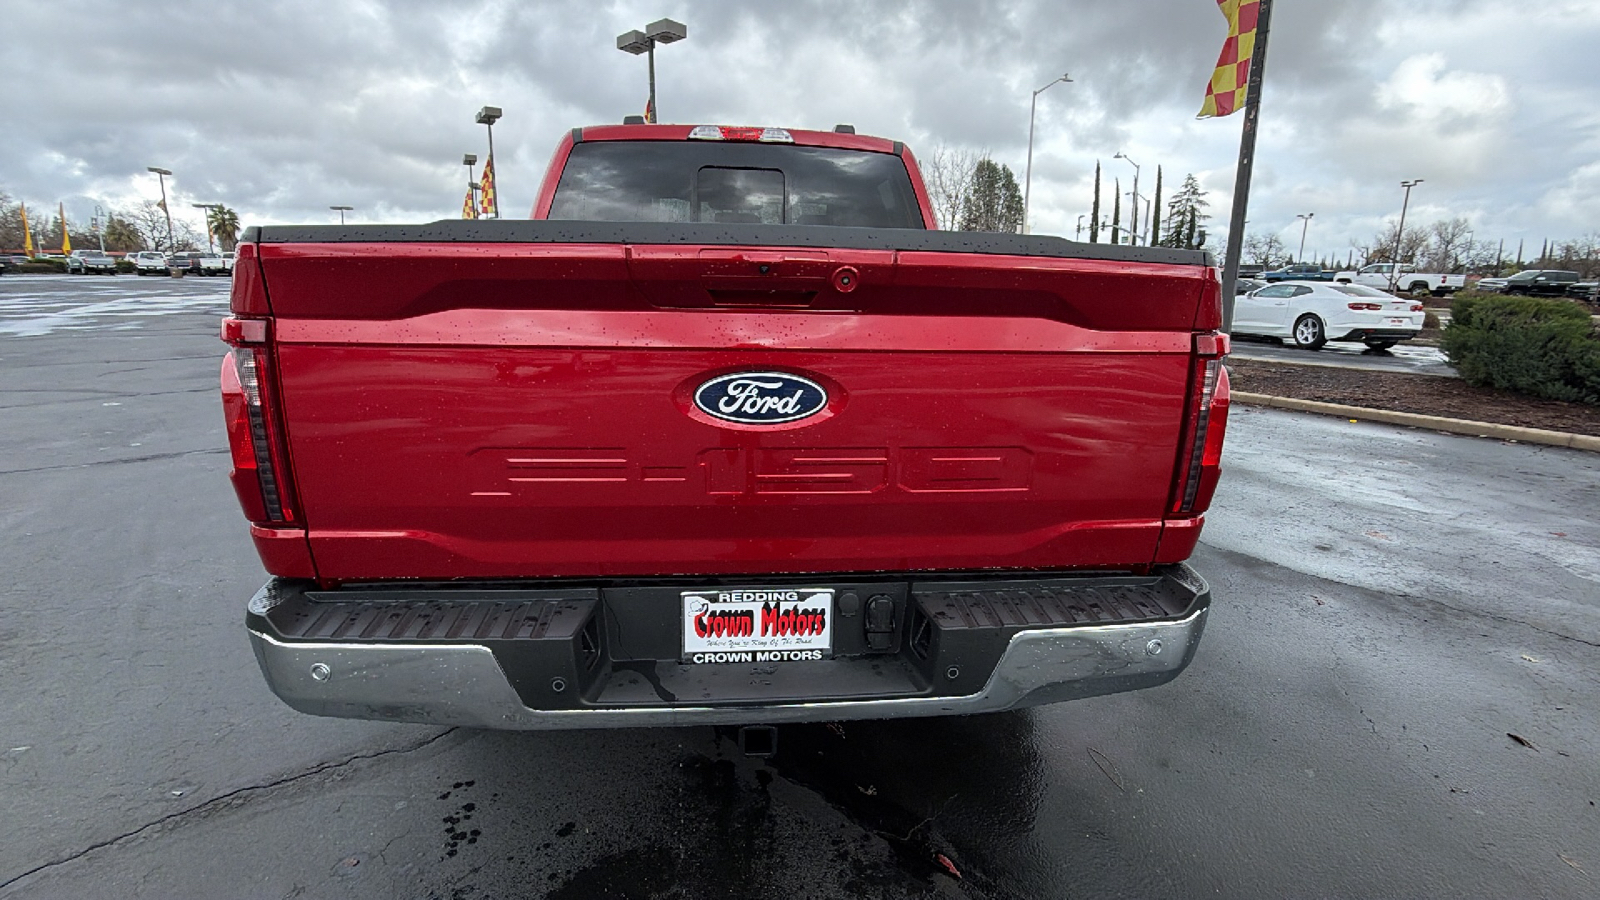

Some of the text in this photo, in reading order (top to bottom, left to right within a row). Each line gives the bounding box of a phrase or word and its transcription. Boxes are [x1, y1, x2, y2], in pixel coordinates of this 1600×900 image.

[718, 379, 804, 414] Ford
[719, 592, 798, 602] REDDING
[694, 602, 825, 638] Crown Motors
[751, 639, 767, 647] King
[781, 637, 793, 645] The
[794, 637, 813, 645] Road
[693, 650, 822, 664] CROWN MOTORS
